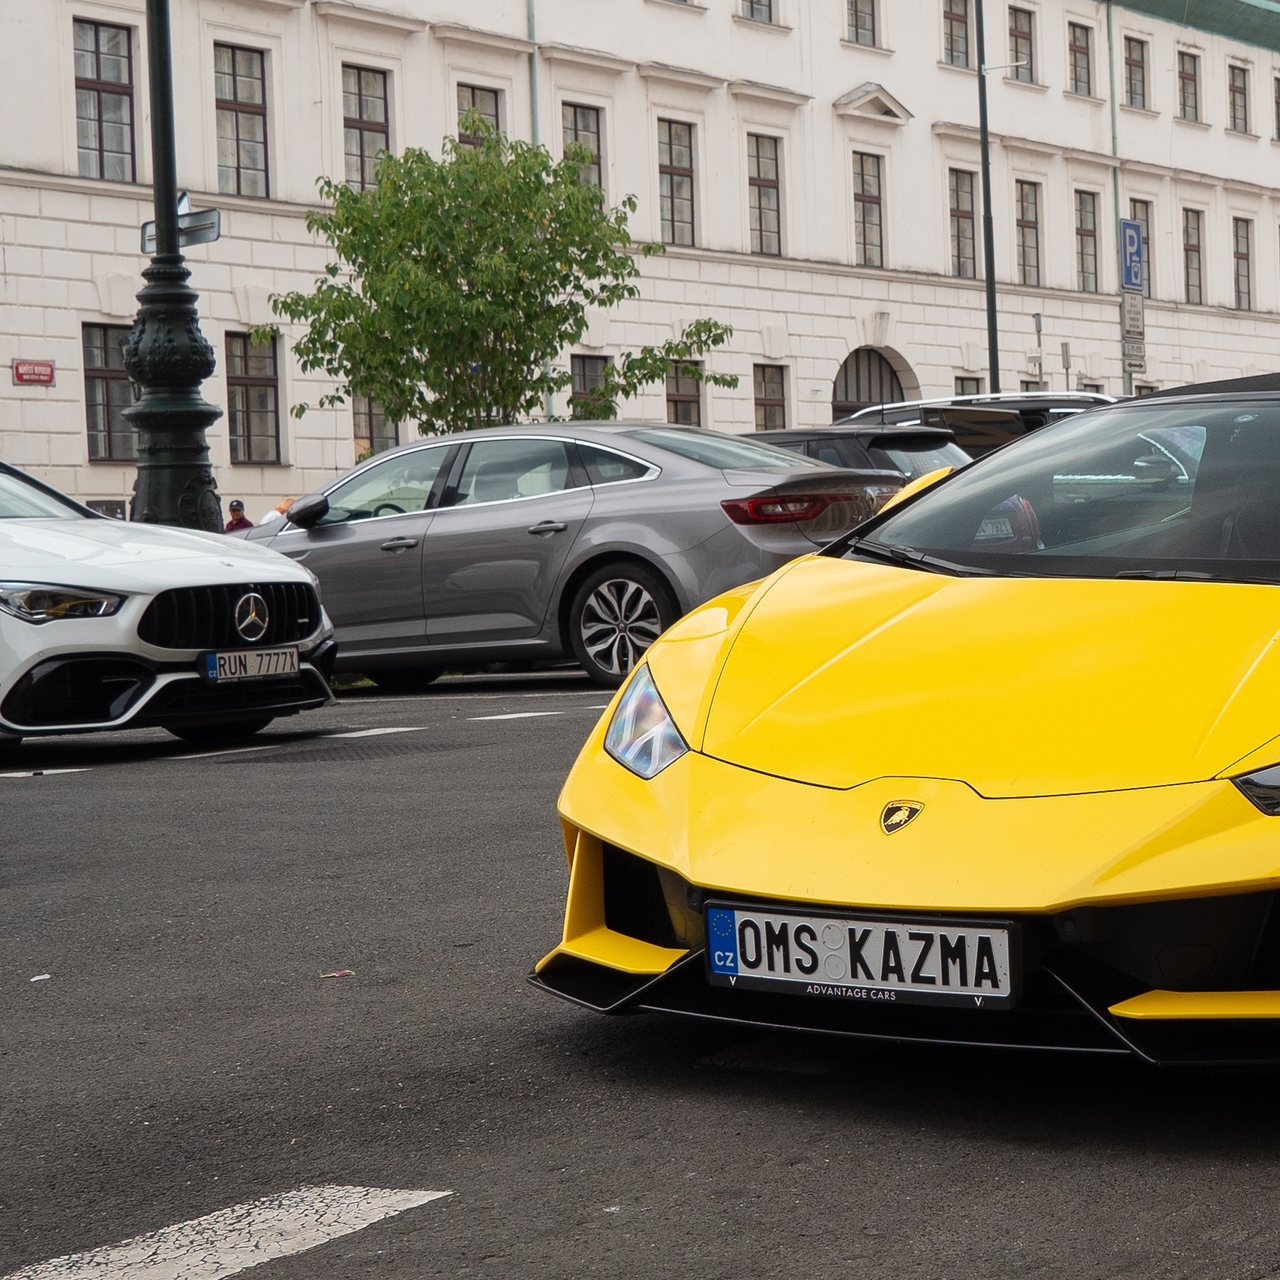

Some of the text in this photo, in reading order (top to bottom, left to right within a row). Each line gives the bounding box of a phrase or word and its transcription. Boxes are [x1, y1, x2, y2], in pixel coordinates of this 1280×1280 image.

[217, 654, 248, 677] RUN
[256, 650, 296, 674] 7777X
[714, 917, 1001, 989] CZ OMS KAZMA
[806, 984, 897, 1001] ADVANTAGE CARS
